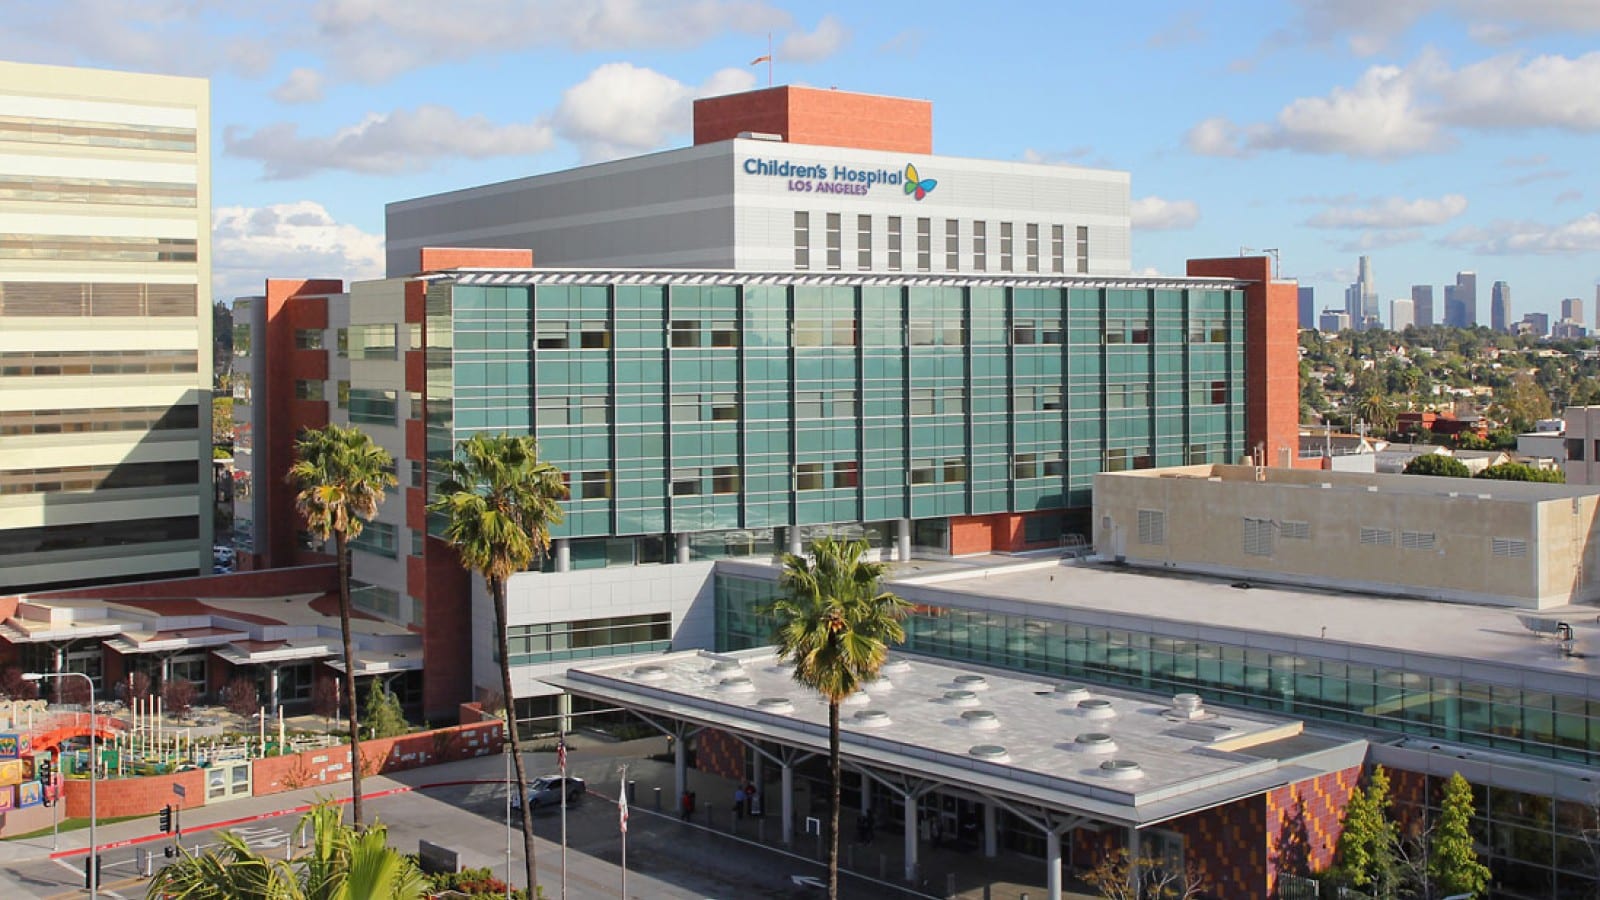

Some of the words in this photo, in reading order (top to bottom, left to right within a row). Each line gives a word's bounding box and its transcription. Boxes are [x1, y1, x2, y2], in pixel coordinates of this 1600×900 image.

[743, 158, 827, 179] Children's
[833, 165, 903, 189] Hospital
[788, 180, 813, 192] LOS
[815, 181, 868, 196] ANGELES
